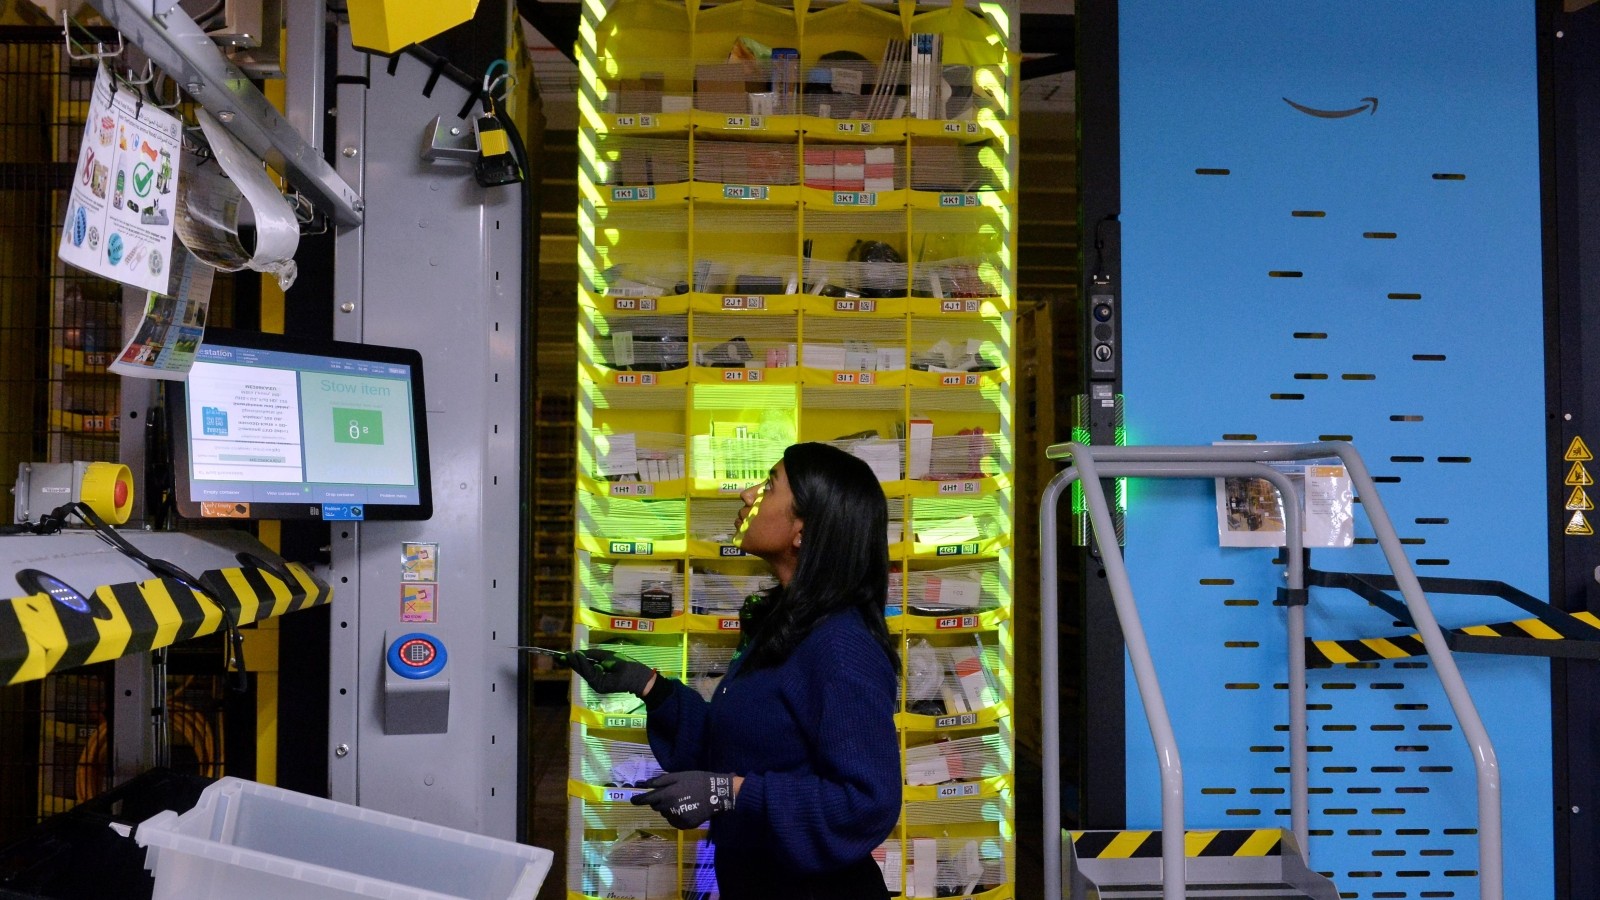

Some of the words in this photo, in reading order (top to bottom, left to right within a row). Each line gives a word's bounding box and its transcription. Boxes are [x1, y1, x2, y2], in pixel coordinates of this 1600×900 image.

[728, 188, 739, 196] 2K
[321, 380, 357, 393] Stow
[361, 382, 391, 396] item
[723, 547, 735, 555] 2G
[940, 546, 952, 554] 4G
[723, 620, 734, 628] 2F
[940, 619, 951, 627] 4F
[939, 718, 950, 726] 4E
[941, 788, 952, 796] 4D
